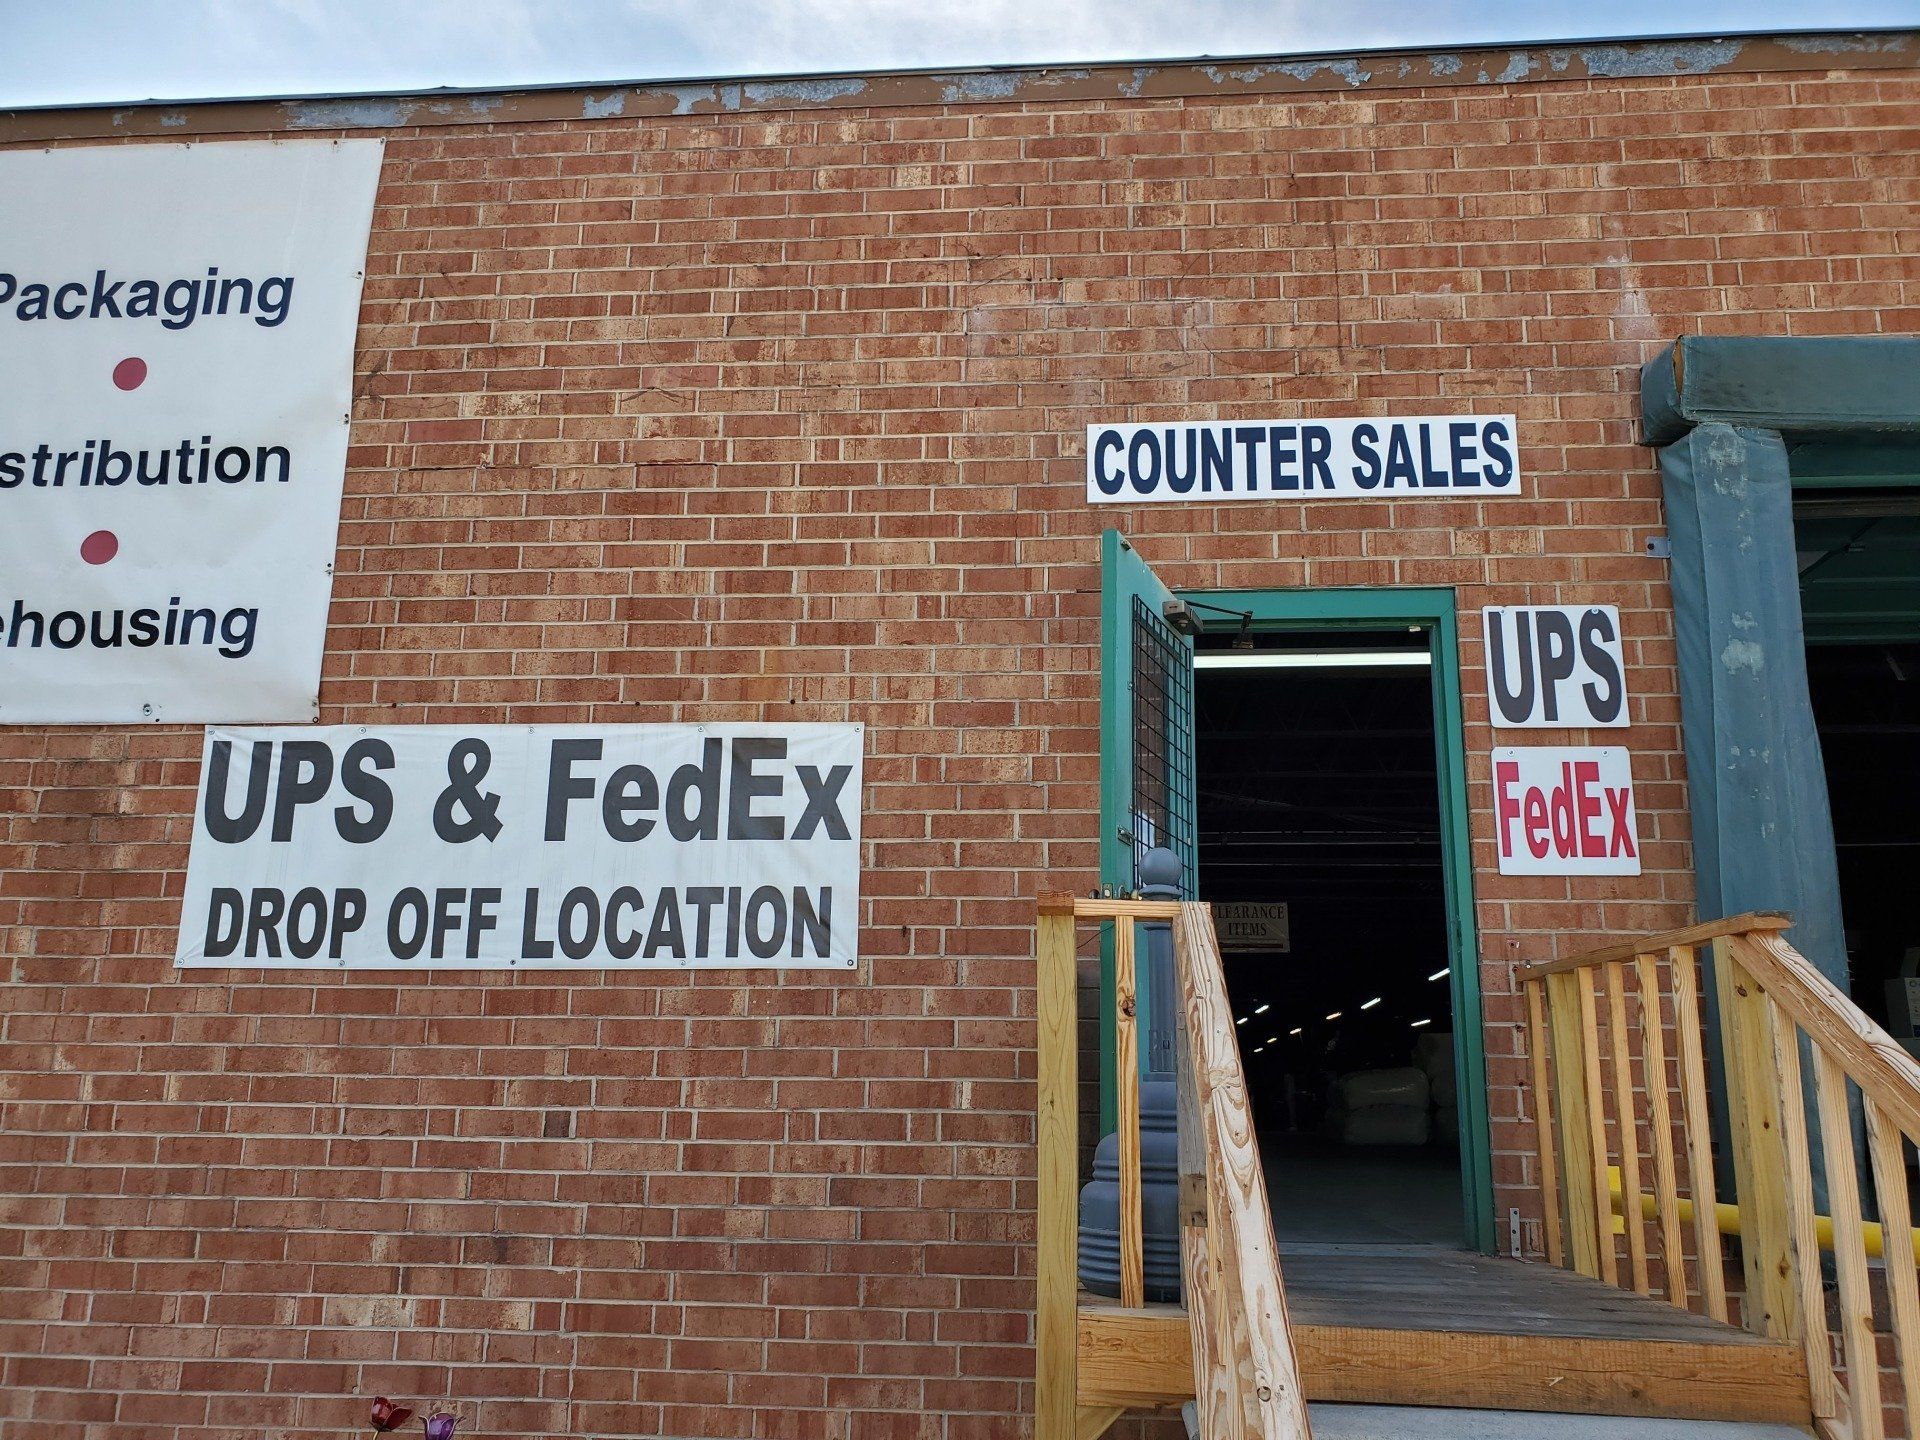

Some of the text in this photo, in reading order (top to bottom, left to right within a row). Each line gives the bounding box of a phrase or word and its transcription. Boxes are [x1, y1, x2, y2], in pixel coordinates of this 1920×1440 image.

[0, 436, 291, 489] stribution
[1094, 421, 1513, 495] COUNTER SALES
[0, 596, 258, 659] housing
[1488, 608, 1622, 724] UPS
[204, 737, 853, 845] UPS & FedEx
[1495, 761, 1636, 860] FedEx
[203, 885, 833, 961] DROP OFF LOCATION
[1228, 922, 1267, 936] ITEMS
